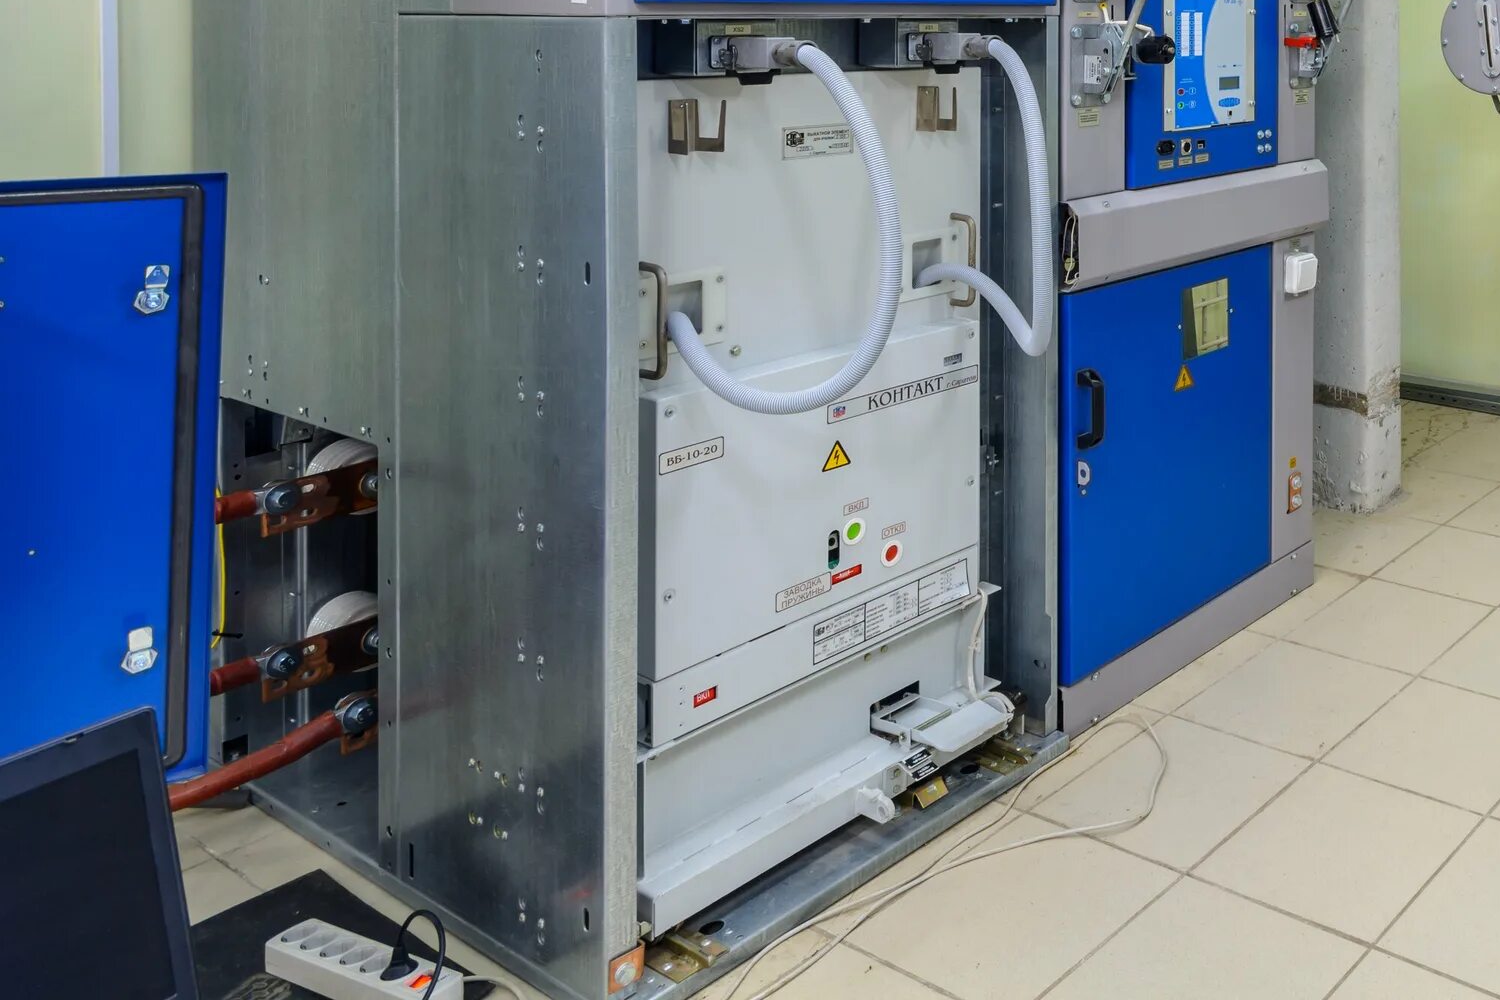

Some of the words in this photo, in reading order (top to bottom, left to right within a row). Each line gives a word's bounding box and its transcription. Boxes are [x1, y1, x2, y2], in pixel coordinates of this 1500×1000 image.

[868, 376, 944, 411] КОНТАКТ
[666, 444, 718, 467] ВБ-10-20
[848, 500, 865, 513] ВКЛ
[883, 523, 905, 538] ОТКЛ
[781, 585, 825, 609] ПРУЖИНЫ
[783, 578, 823, 599] ЗАВОДКА
